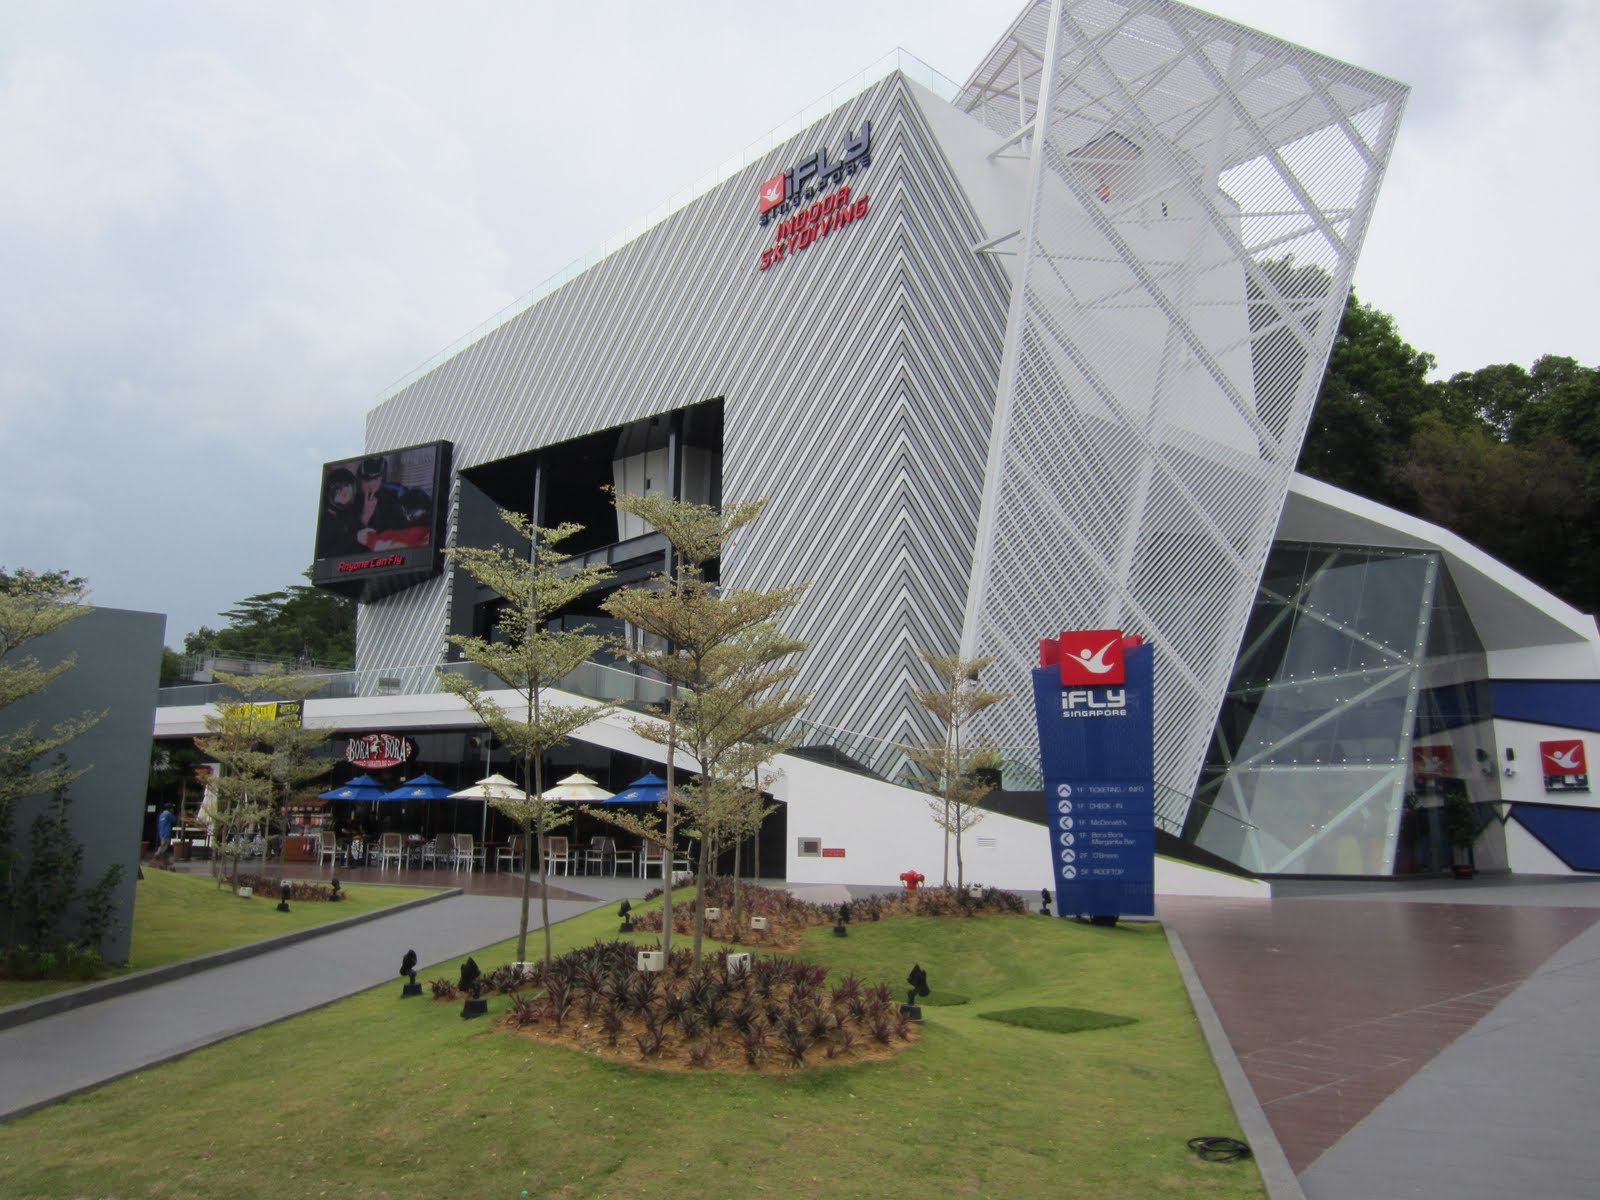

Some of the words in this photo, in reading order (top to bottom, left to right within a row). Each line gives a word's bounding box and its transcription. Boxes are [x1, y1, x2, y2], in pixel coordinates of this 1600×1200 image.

[776, 186, 851, 242] INDOOR
[759, 195, 869, 271] SKYDIVING
[338, 560, 370, 572] Anyone
[370, 557, 388, 568] Can
[388, 554, 404, 565] Fly
[1061, 689, 1126, 709] iFLY
[1063, 709, 1127, 718] SINGAPORE
[348, 738, 370, 762] BORA
[384, 736, 406, 762] BORA
[1128, 785, 1145, 793] INFO
